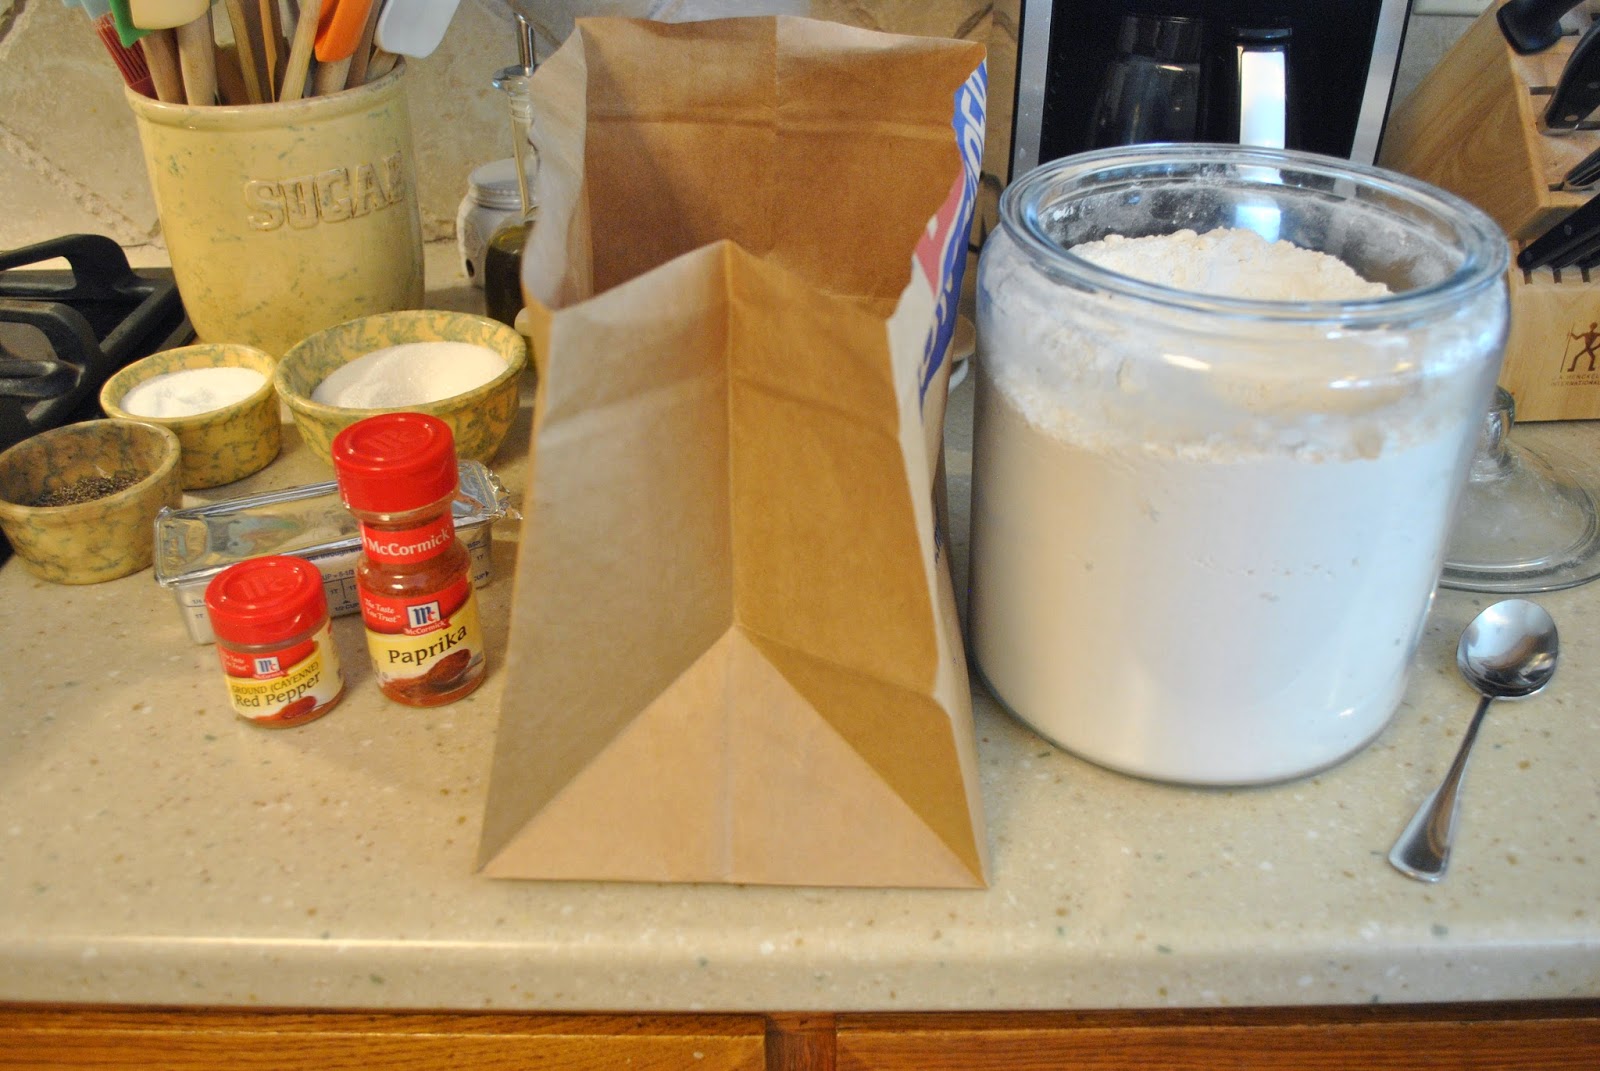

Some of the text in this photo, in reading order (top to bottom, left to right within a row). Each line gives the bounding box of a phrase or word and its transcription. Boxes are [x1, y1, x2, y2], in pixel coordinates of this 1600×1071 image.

[366, 527, 451, 557] McCormick
[404, 620, 447, 636] McCormick
[388, 625, 467, 667] Paprika
[235, 671, 321, 708] Red Pepper
[270, 661, 319, 693] (CAYENNE)
